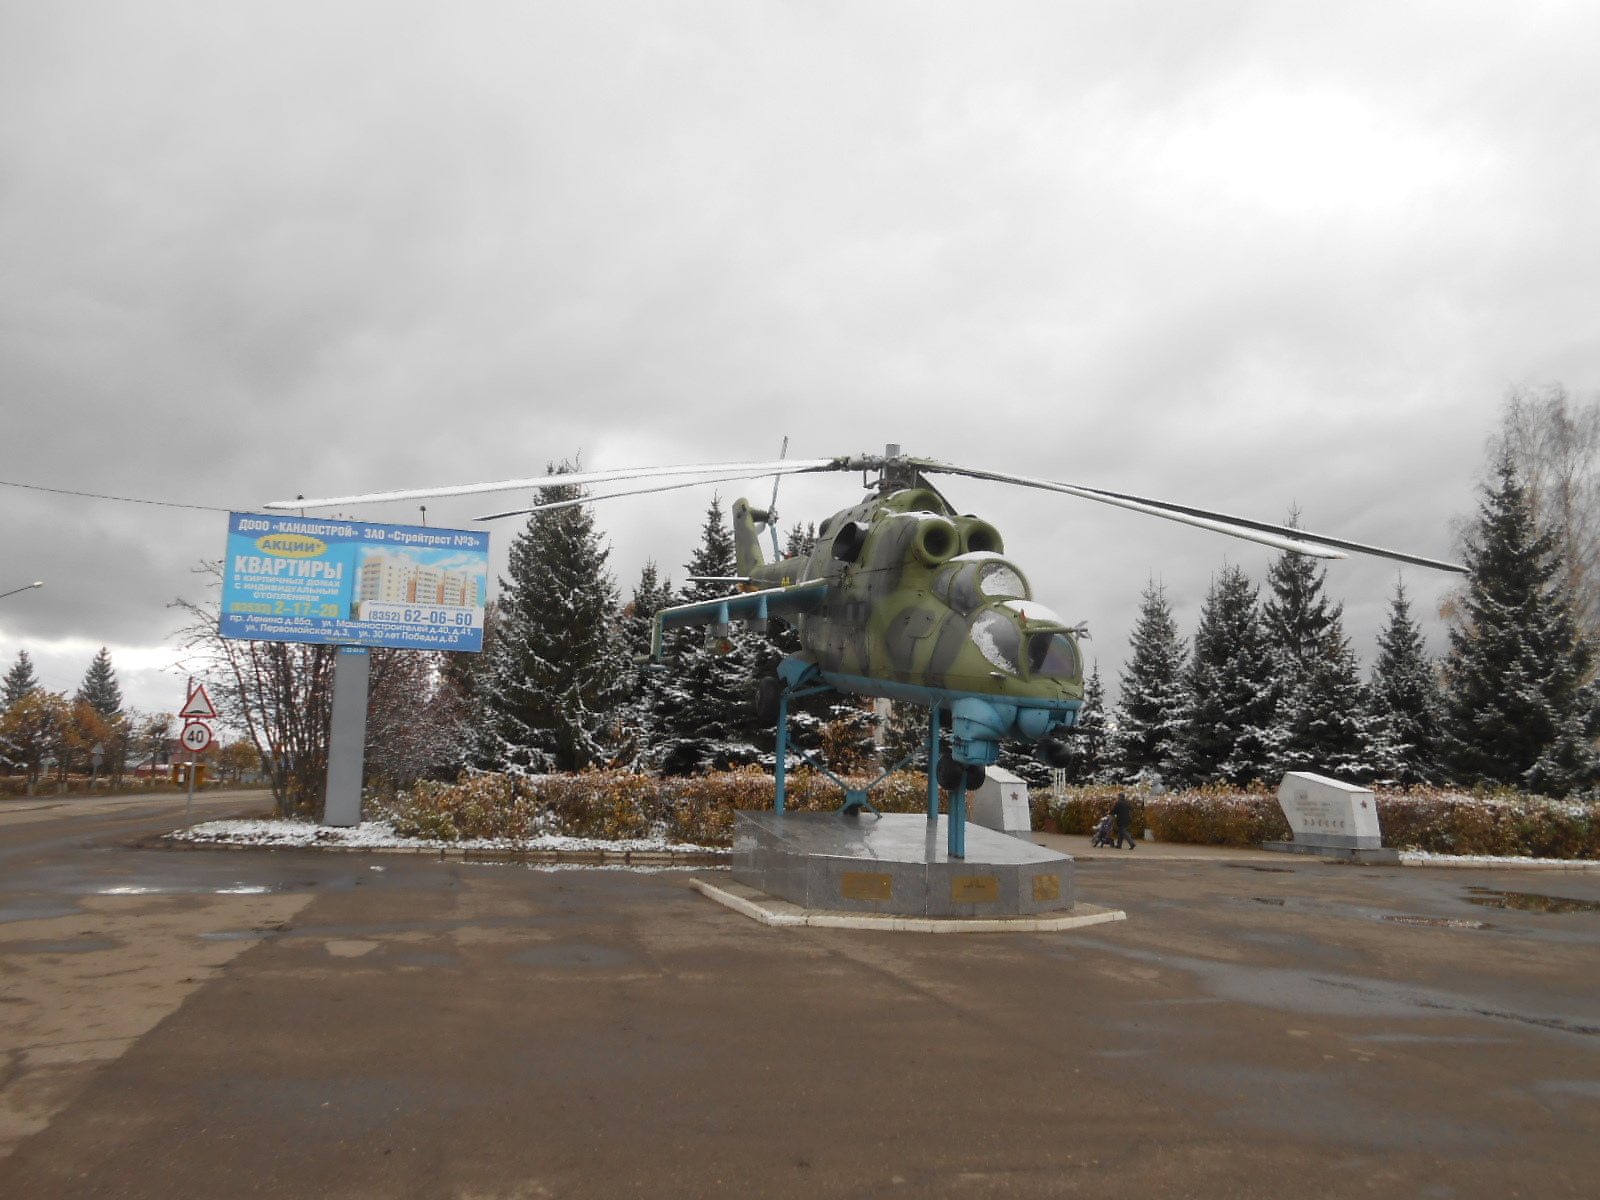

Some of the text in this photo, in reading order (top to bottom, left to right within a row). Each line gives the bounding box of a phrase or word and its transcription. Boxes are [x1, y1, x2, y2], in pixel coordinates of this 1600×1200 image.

[238, 519, 270, 531] ДООО
[272, 522, 359, 537] «КАНАШСТРОЙ»
[364, 528, 385, 540] ЗАО
[387, 530, 451, 546] «Стройтрест
[234, 555, 344, 580] КВАРТИРЫ
[243, 575, 305, 585] КИРПИЧНЫХ
[305, 579, 341, 587] ДОМАХ
[243, 583, 339, 595] ИНДИВИДУАЛЬНЫМ
[253, 591, 320, 602] ОТОПЛЕНИЕМ
[274, 601, 339, 618] 2-17-20
[368, 609, 473, 626] (8352) 62-06-60
[260, 624, 332, 636] Первомайская
[187, 730, 204, 743] 40
